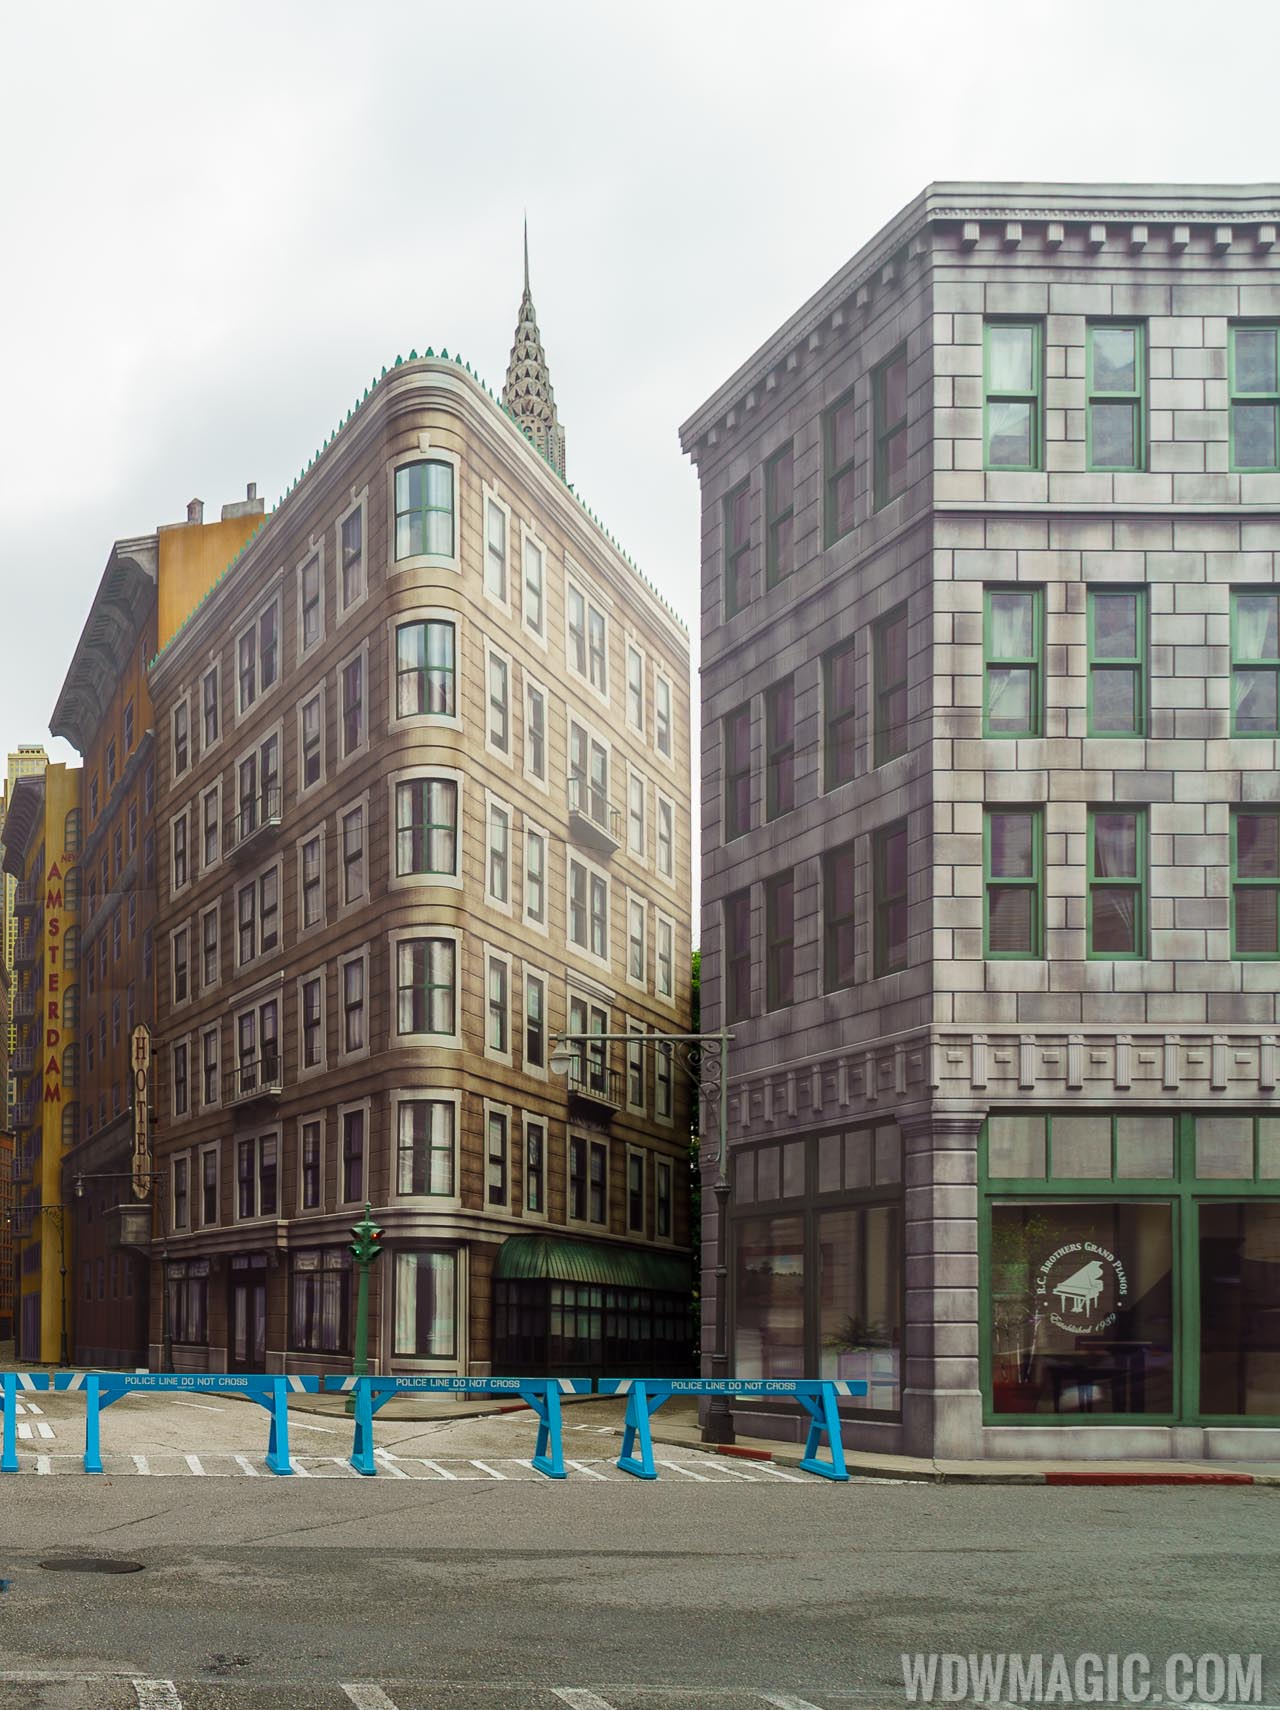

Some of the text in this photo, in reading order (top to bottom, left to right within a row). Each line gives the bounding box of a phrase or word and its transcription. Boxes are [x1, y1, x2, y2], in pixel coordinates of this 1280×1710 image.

[44, 861, 64, 1102] AMSTERDAM
[134, 1037, 147, 1187] HOTEL
[1040, 1243, 1082, 1274] BROTHERS
[1036, 1276, 1047, 1294] R.C.
[1112, 1260, 1128, 1295] PIANOS
[124, 1376, 248, 1386] POLICE LINE DO NOT CROSS
[396, 1378, 520, 1388] POLICE LINE DO NOT CROSS
[671, 1381, 796, 1391] POLICE LINE DO NOT CROSS
